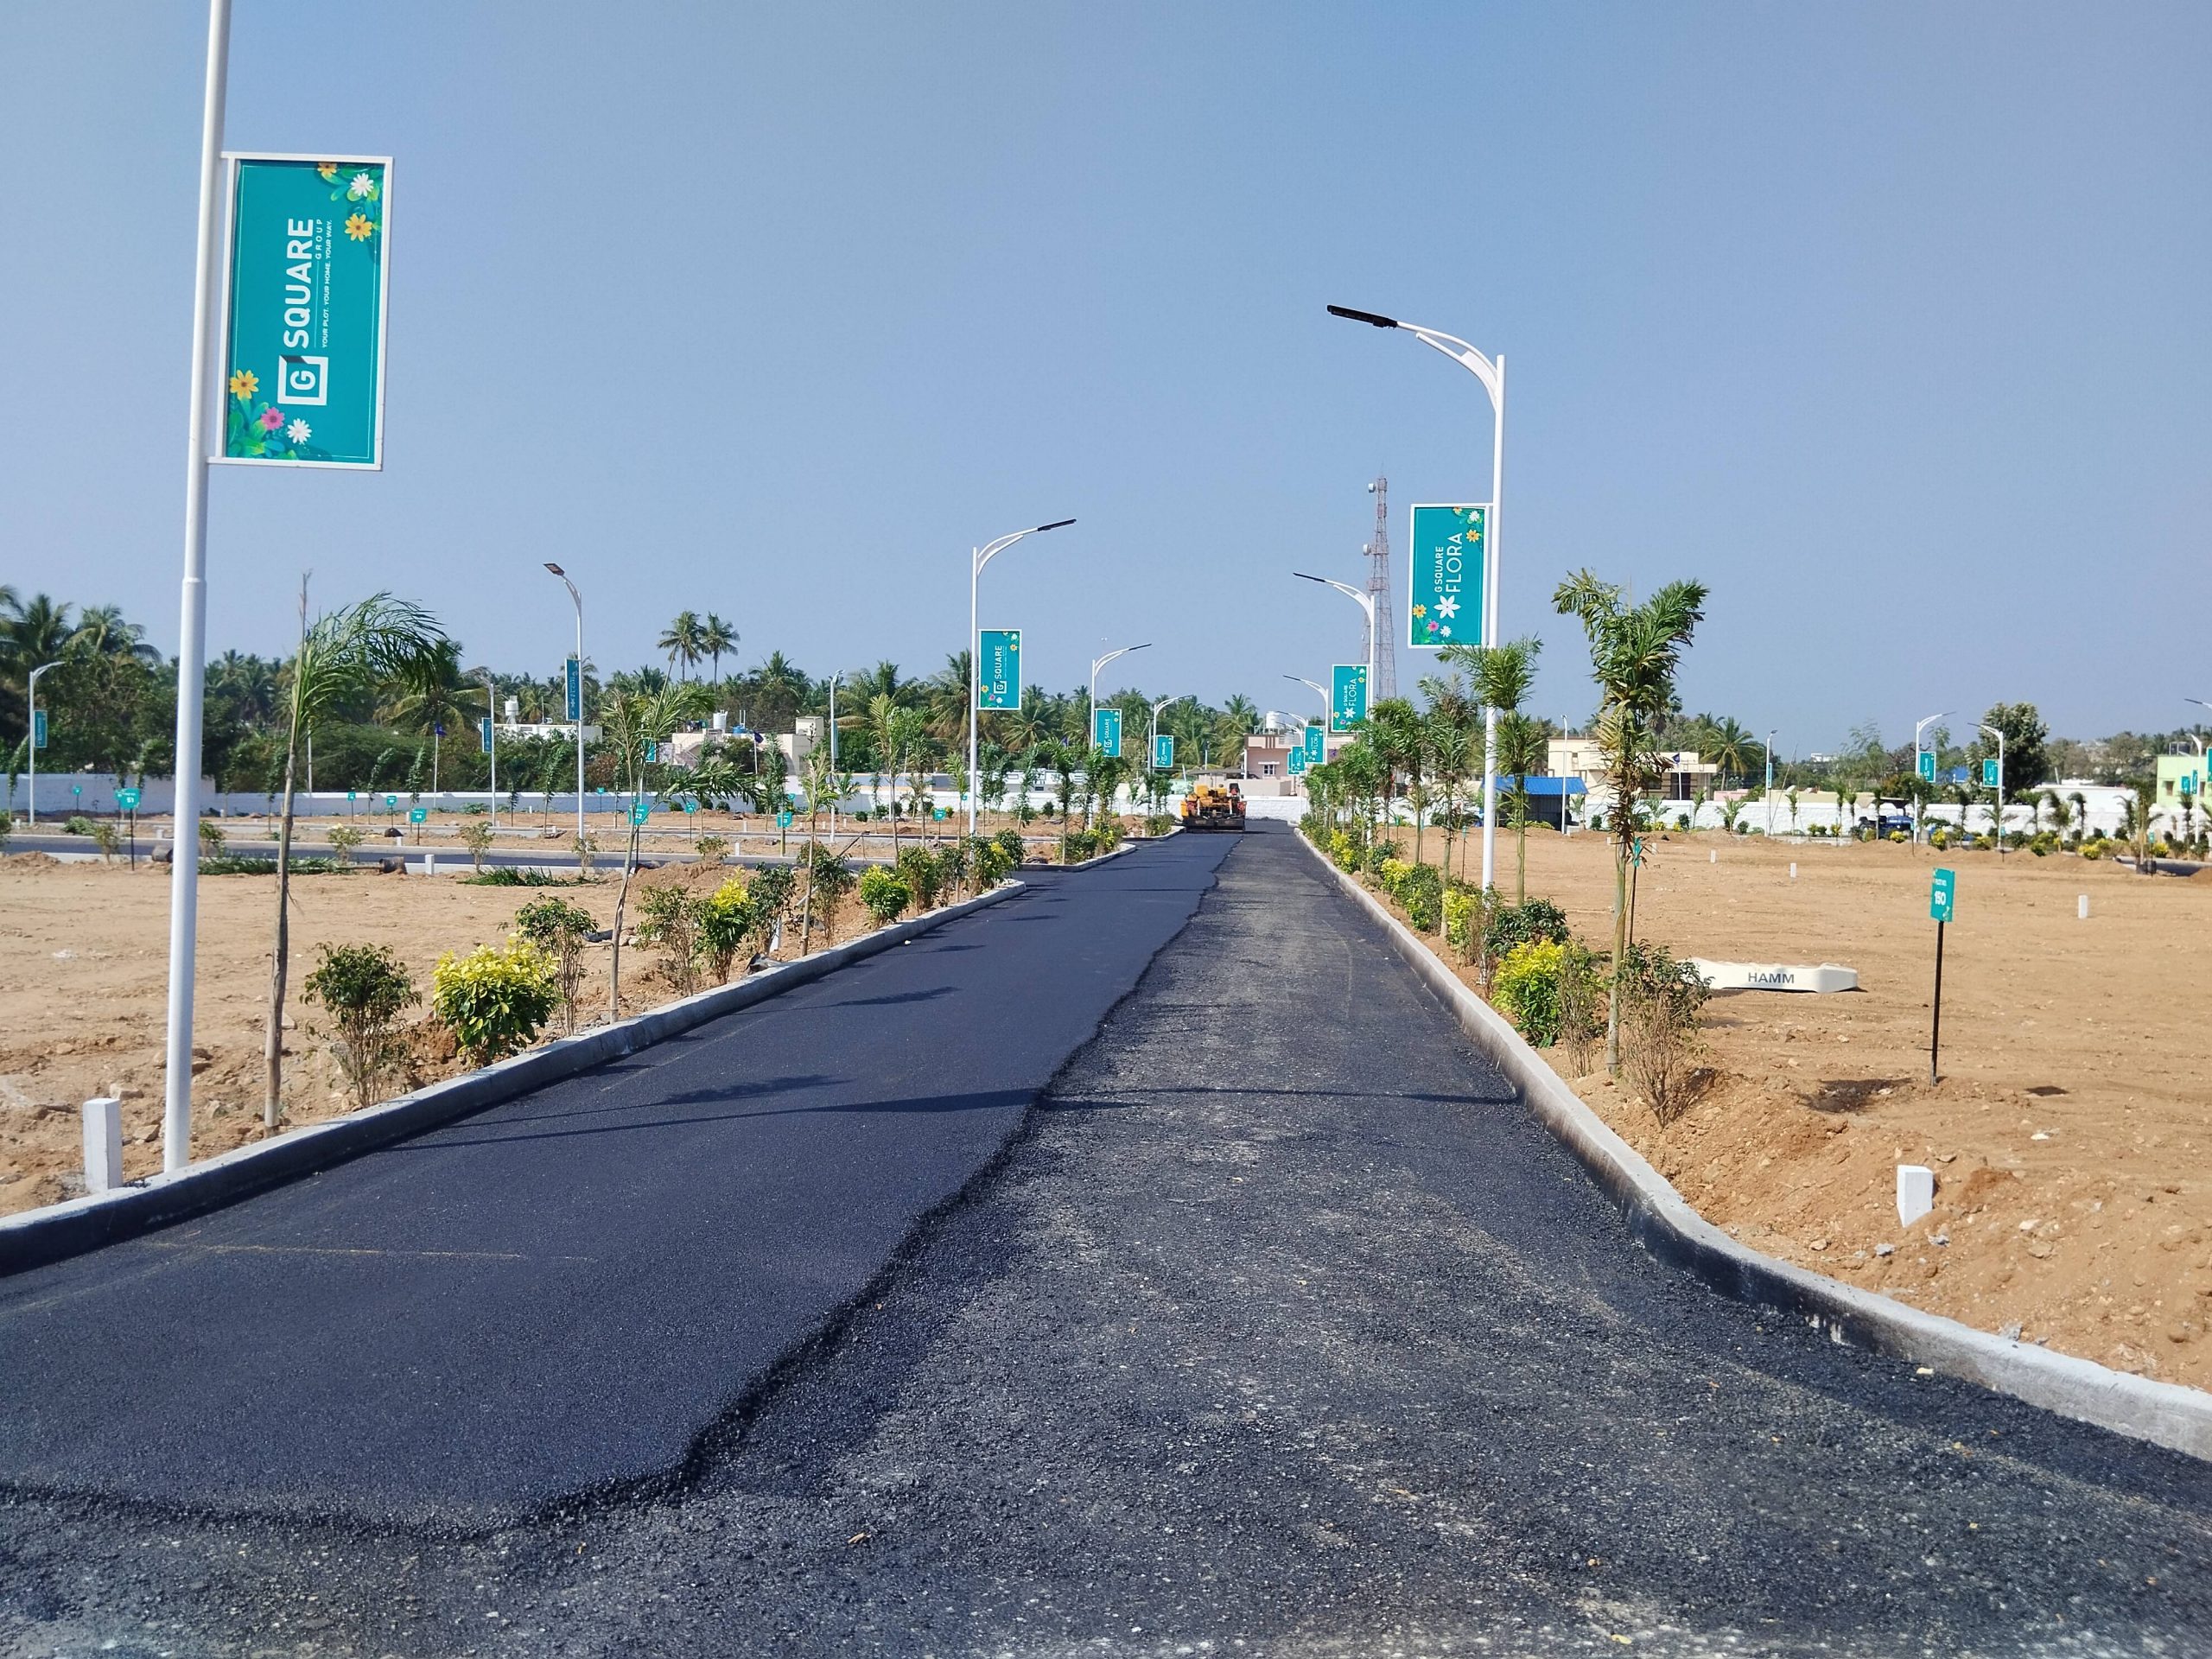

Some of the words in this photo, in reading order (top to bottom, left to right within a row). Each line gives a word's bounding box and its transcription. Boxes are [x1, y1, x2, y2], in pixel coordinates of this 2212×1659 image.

[283, 218, 314, 349] SQUARE
[289, 370, 316, 391] G
[1434, 546, 1444, 585] SQUARE
[1445, 532, 1463, 594] FLORA
[1348, 678, 1357, 707] FLORA
[1748, 971, 1795, 984] HAMM
